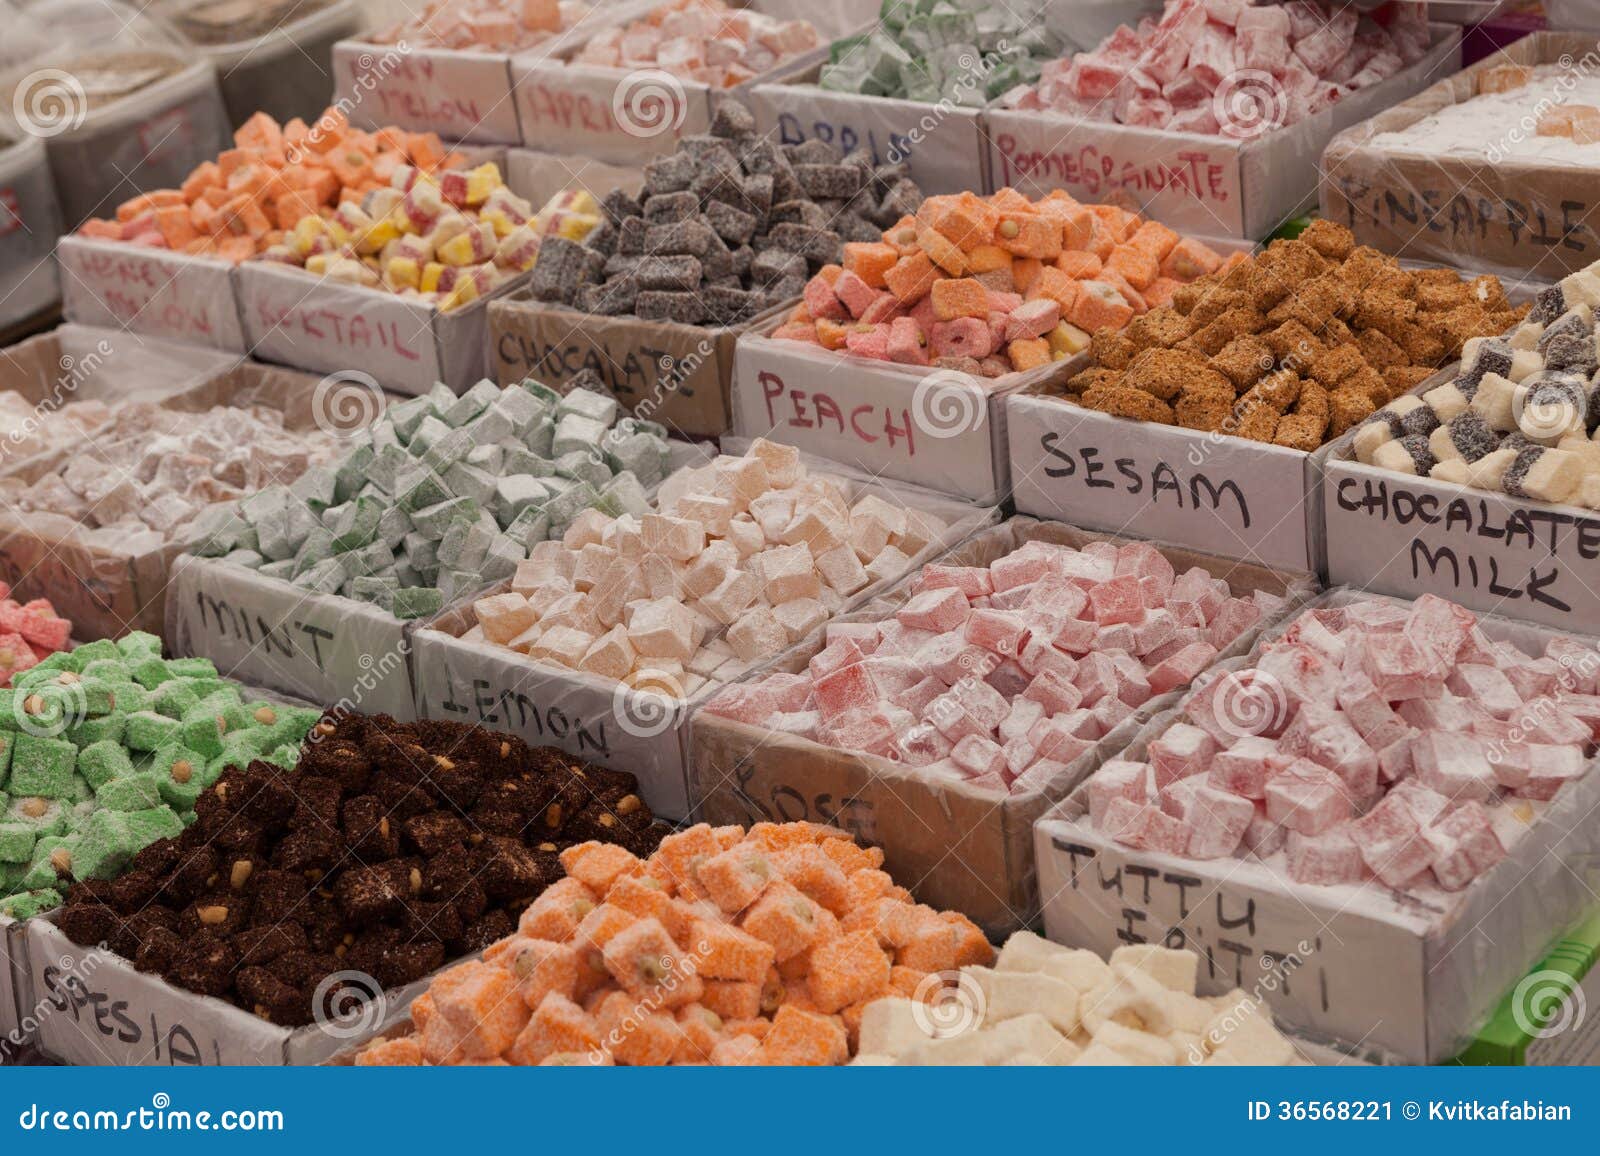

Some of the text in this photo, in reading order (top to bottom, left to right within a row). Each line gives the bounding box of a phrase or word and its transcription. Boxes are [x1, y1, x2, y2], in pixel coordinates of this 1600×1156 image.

[997, 133, 1228, 201] POMEGRANATE
[1340, 176, 1586, 251] PINEAPPLE
[758, 370, 915, 457] PEACH
[1041, 432, 1251, 529] SESAM
[1337, 478, 1600, 560] CHOCALATE
[1410, 538, 1572, 612] MILK
[197, 590, 334, 673] MINT
[442, 662, 611, 759] LEMON
[1052, 836, 1256, 937] TUTTU
